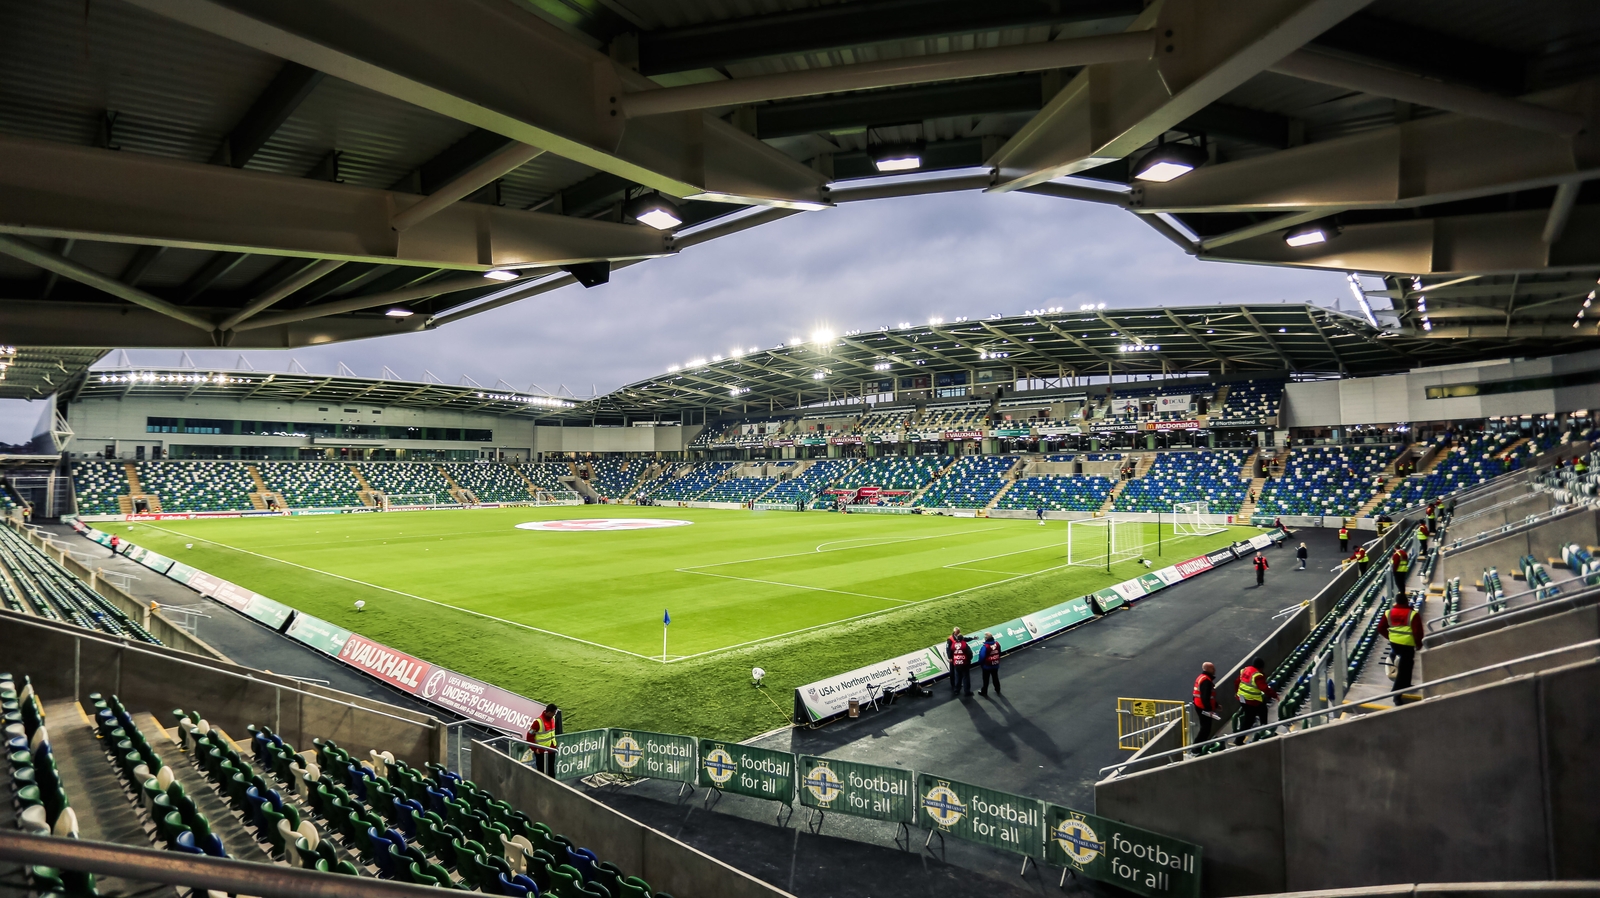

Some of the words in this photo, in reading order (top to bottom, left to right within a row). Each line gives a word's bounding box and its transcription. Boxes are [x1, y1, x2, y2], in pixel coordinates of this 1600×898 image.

[1155, 421, 1199, 429] McDonald's
[350, 641, 422, 688] VAUXHALL
[448, 676, 461, 686] UEFA
[460, 680, 485, 694] WOMEN'S
[818, 685, 836, 697] USA
[835, 684, 841, 692] v
[840, 675, 871, 689] Northern
[870, 667, 892, 680] Ireland
[442, 684, 479, 707] UNDER-19
[558, 736, 605, 756] football
[647, 739, 692, 758] football
[556, 760, 575, 774] for
[577, 755, 590, 770] all
[647, 757, 664, 772] for
[666, 758, 680, 774] all
[741, 753, 790, 777] football
[741, 773, 758, 790] for
[760, 777, 776, 794] all
[848, 771, 908, 796] football
[849, 792, 870, 809] for
[871, 797, 891, 814] all
[972, 795, 1038, 827] football
[972, 819, 996, 838] for
[1001, 827, 1019, 844] all
[1057, 832, 1079, 844] NORTHERN
[1078, 840, 1098, 849] IRELAND
[1112, 833, 1194, 874] football
[1111, 857, 1140, 881] for
[1145, 869, 1169, 891] all
